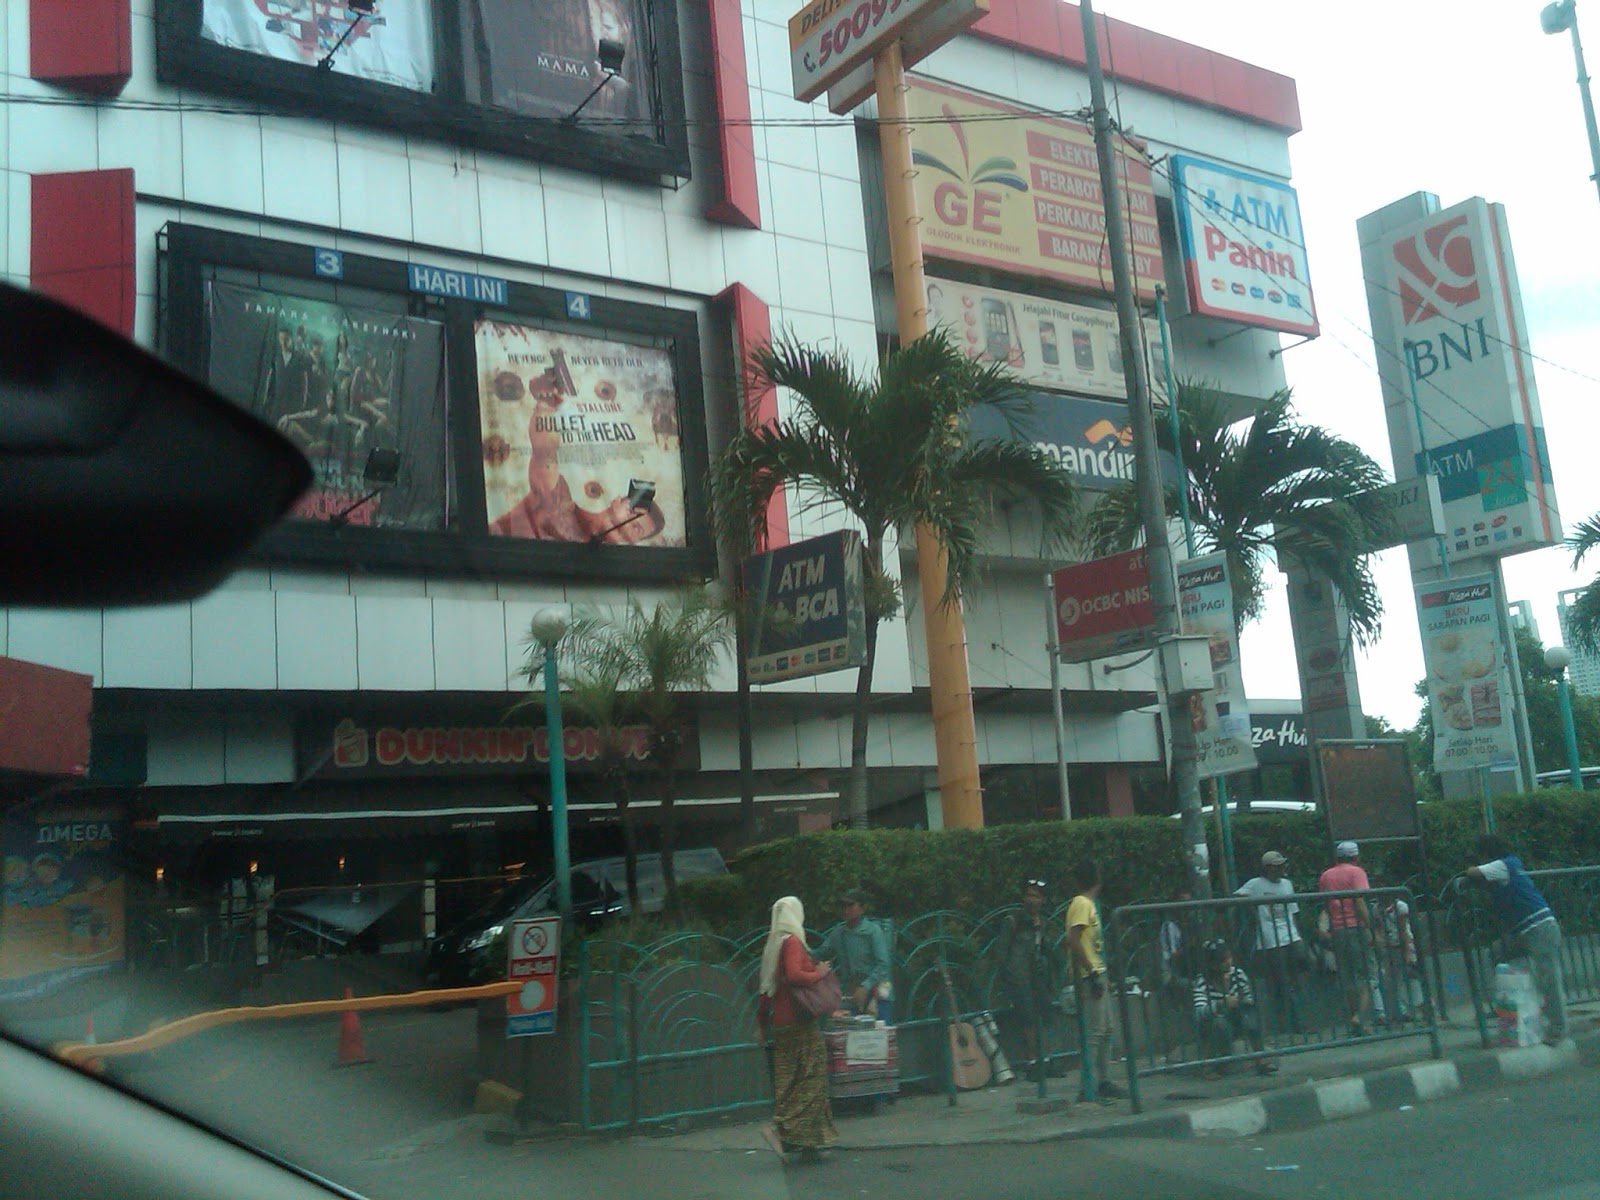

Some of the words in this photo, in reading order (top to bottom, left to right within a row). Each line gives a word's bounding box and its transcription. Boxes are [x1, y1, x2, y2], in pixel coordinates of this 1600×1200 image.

[538, 56, 590, 77] MAMA
[934, 181, 1003, 236] GE
[1231, 193, 1290, 237] ATM
[318, 252, 341, 275] 3
[1203, 225, 1297, 280] Panin
[414, 267, 466, 297] HARI
[473, 278, 502, 303] INI
[569, 295, 588, 318] 4
[1408, 316, 1492, 382] BNI
[535, 413, 586, 433] BULLET
[561, 431, 574, 444] TO
[577, 430, 593, 443] THE
[591, 422, 637, 442] HEAD
[1030, 441, 1136, 480] mandir
[1476, 457, 1517, 495] 24
[778, 553, 826, 594] ATM
[795, 587, 840, 625] BCA
[1081, 592, 1121, 614] OCBC
[1124, 585, 1153, 606] NIS
[1200, 598, 1225, 612] PAGI
[1469, 613, 1490, 624] PAGI
[375, 724, 535, 765] DUNKIN'
